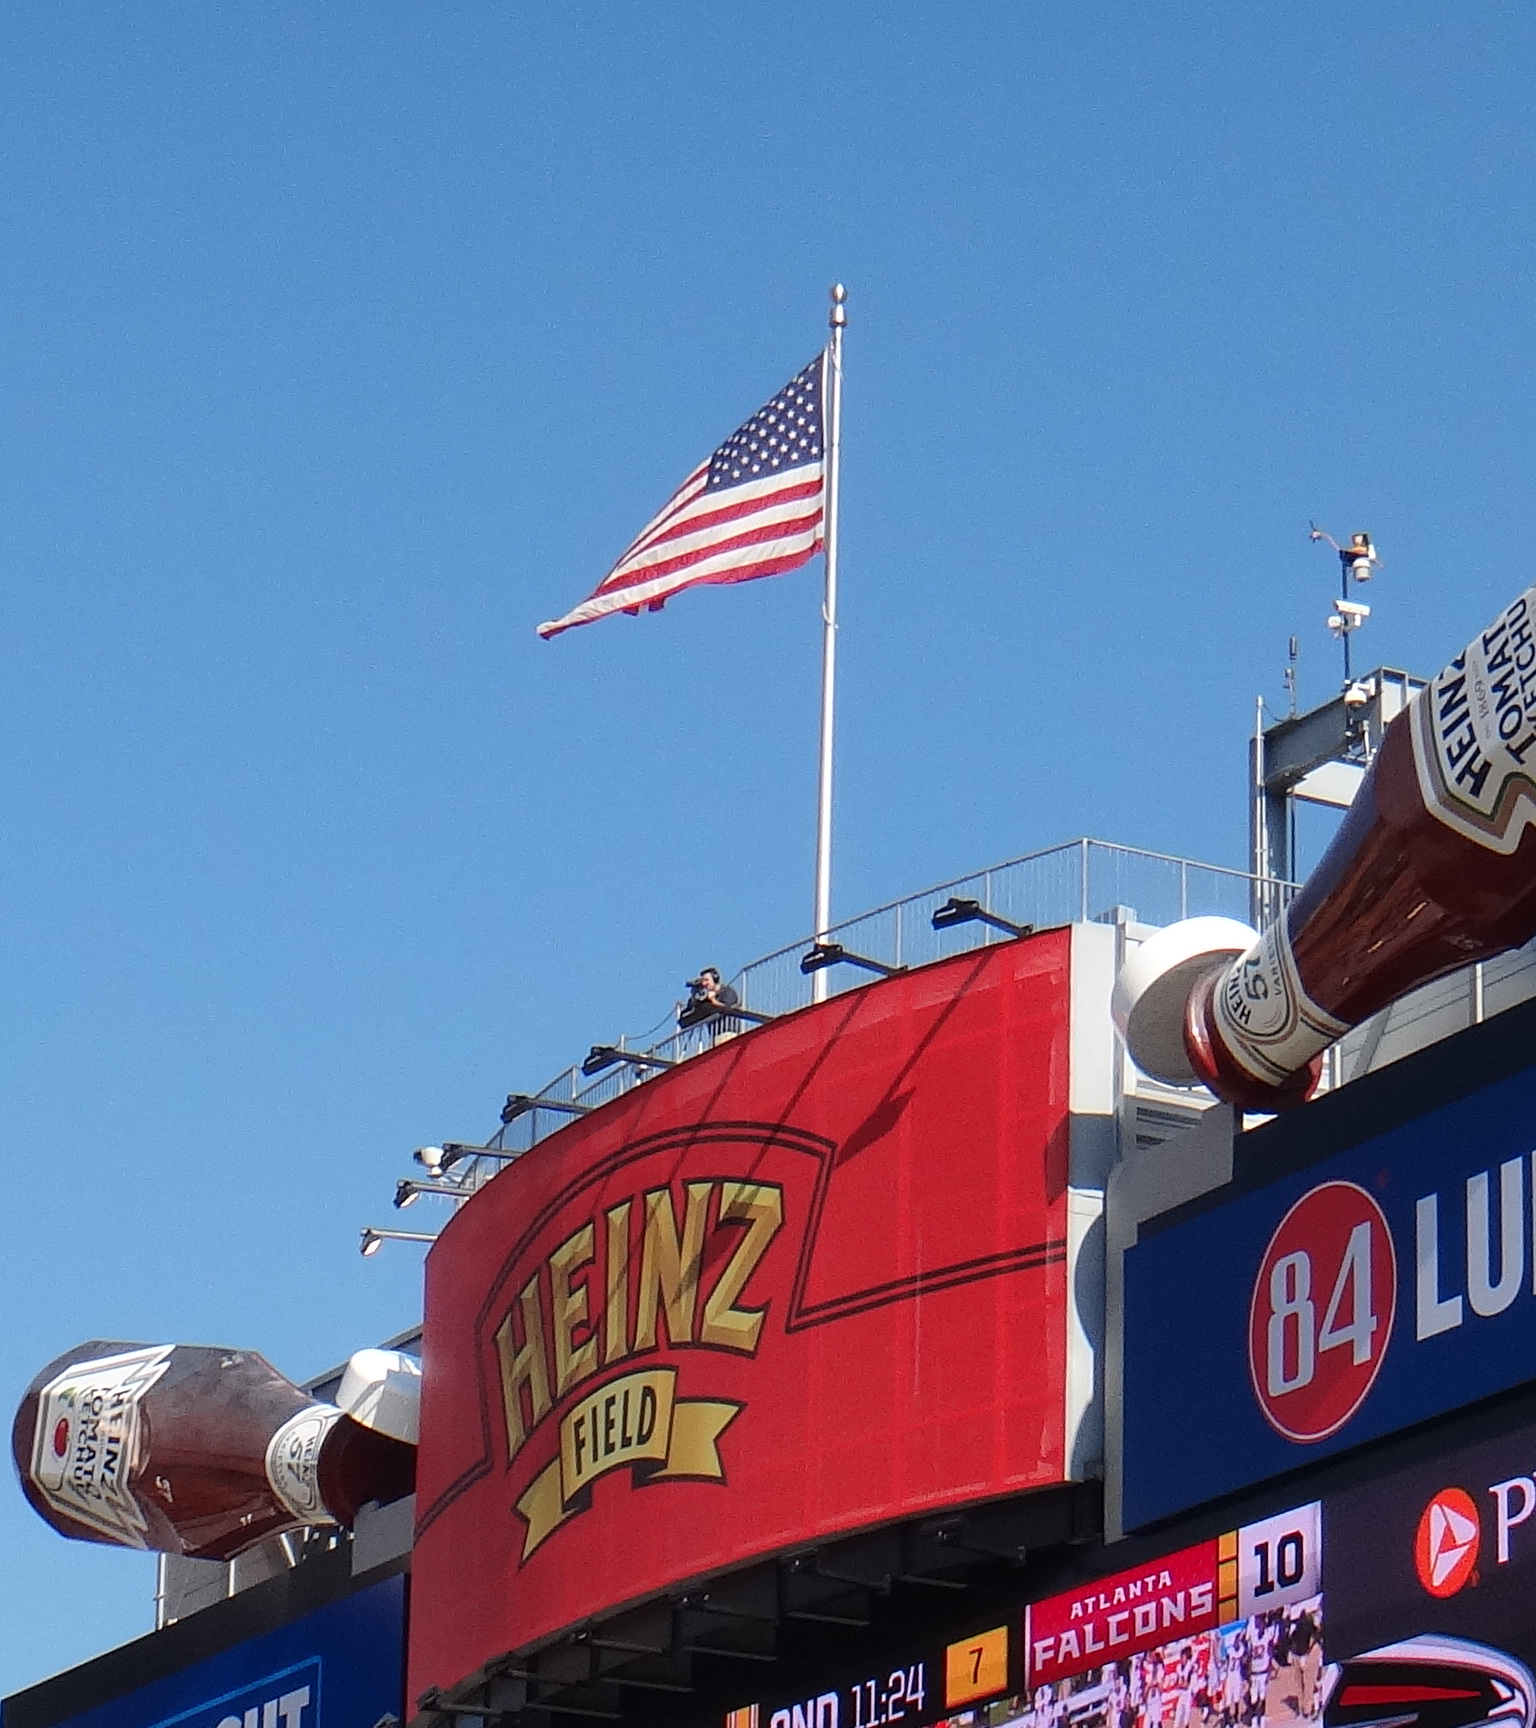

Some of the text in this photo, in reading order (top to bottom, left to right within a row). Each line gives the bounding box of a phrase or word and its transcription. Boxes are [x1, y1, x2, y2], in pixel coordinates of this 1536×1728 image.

[492, 1178, 786, 1466] HEINZ
[1265, 1219, 1380, 1398] 84
[572, 1383, 657, 1478] FIELD
[1069, 1568, 1173, 1619] ATLANTA
[1253, 1530, 1305, 1597] 10
[968, 1645, 985, 1685] 7
[1034, 1582, 1215, 1672] FALCONS
